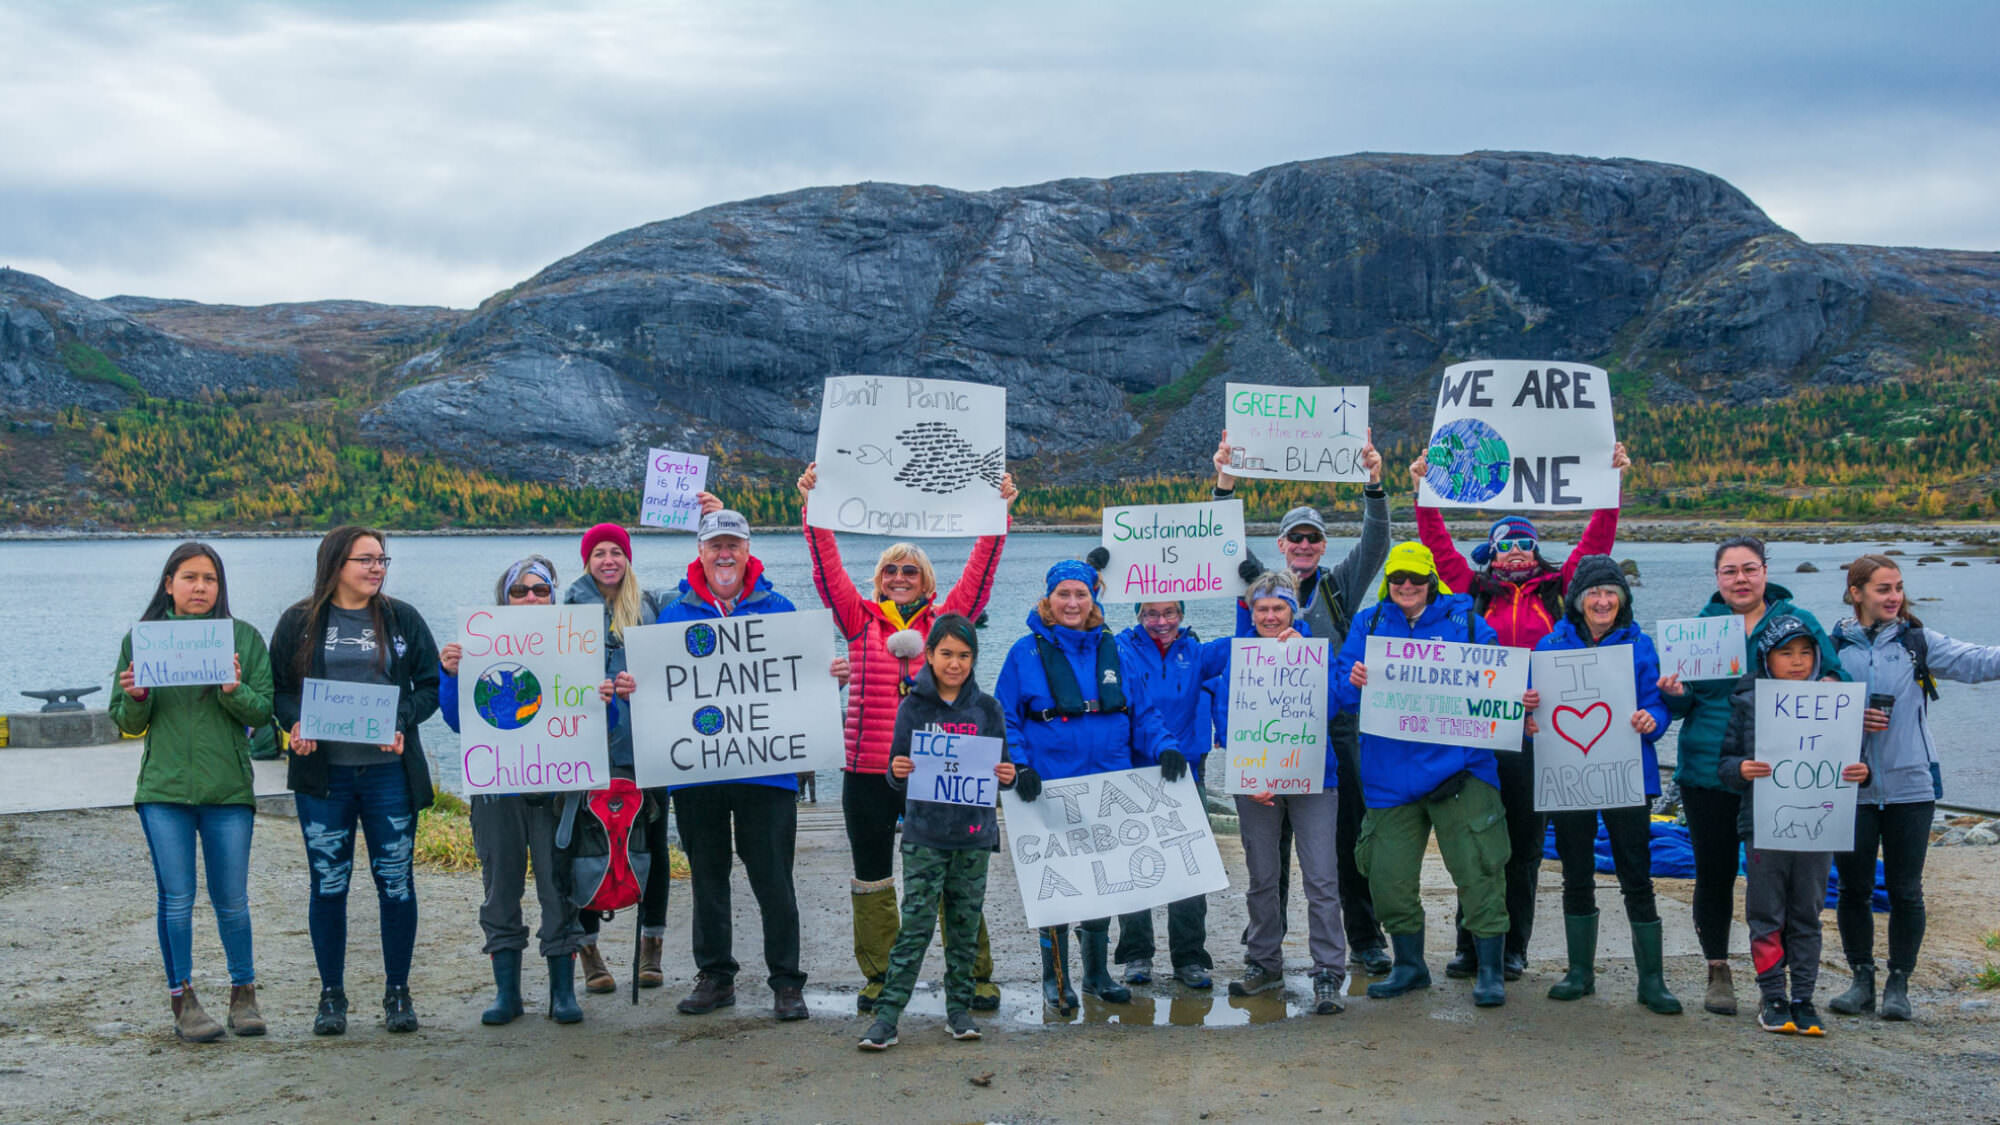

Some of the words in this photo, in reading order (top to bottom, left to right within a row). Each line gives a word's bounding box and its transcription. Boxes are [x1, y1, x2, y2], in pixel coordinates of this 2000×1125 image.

[1441, 369, 1494, 409] WE
[1512, 368, 1596, 409] ARE
[1232, 391, 1316, 419] GREEN
[655, 454, 698, 475] Greta
[1286, 446, 1366, 475] BLACK
[656, 476, 669, 488] is
[676, 476, 690, 492] 16
[645, 493, 669, 507] and
[646, 510, 689, 529] right
[1113, 510, 1224, 541] Sustainable
[1125, 562, 1223, 595] Attainable
[137, 624, 224, 650] Sustainable
[466, 611, 545, 657] Save
[556, 611, 598, 655] the
[1665, 621, 1707, 642] Chill
[1719, 619, 1729, 639] it
[1240, 646, 1276, 666] The
[1386, 641, 1446, 662] LOVE
[1459, 646, 1510, 668] YOUR
[1677, 658, 1701, 676] Kill
[1712, 657, 1723, 674] it
[139, 658, 228, 686] Attainable
[666, 655, 803, 702] PLANET
[1239, 668, 1264, 687] the
[1554, 653, 1600, 702] I
[306, 682, 355, 705] There
[360, 696, 369, 706] is
[376, 697, 391, 707] no
[552, 673, 595, 707] for
[1234, 691, 1257, 710] the
[1372, 691, 1422, 712] SAVE
[1425, 694, 1463, 716] THE
[1466, 698, 1525, 720] WORLD
[1775, 692, 1850, 721] KEEP
[306, 714, 355, 737] Planet
[547, 714, 588, 738] our
[1399, 715, 1430, 733] FOR
[670, 733, 807, 771] CHANCE
[914, 732, 961, 758] ICE
[1800, 734, 1824, 751] IT
[464, 743, 596, 788] Children
[1280, 748, 1301, 768] all
[1240, 769, 1258, 789] be
[1265, 776, 1311, 793] wrong
[1538, 759, 1642, 807] ARCTIC
[1772, 760, 1852, 790] COOL
[934, 775, 991, 805] NICE
[1045, 773, 1182, 824] TAX
[1016, 810, 1187, 864] CARBON
[1038, 865, 1082, 900] A
[1091, 829, 1206, 896] LOT
